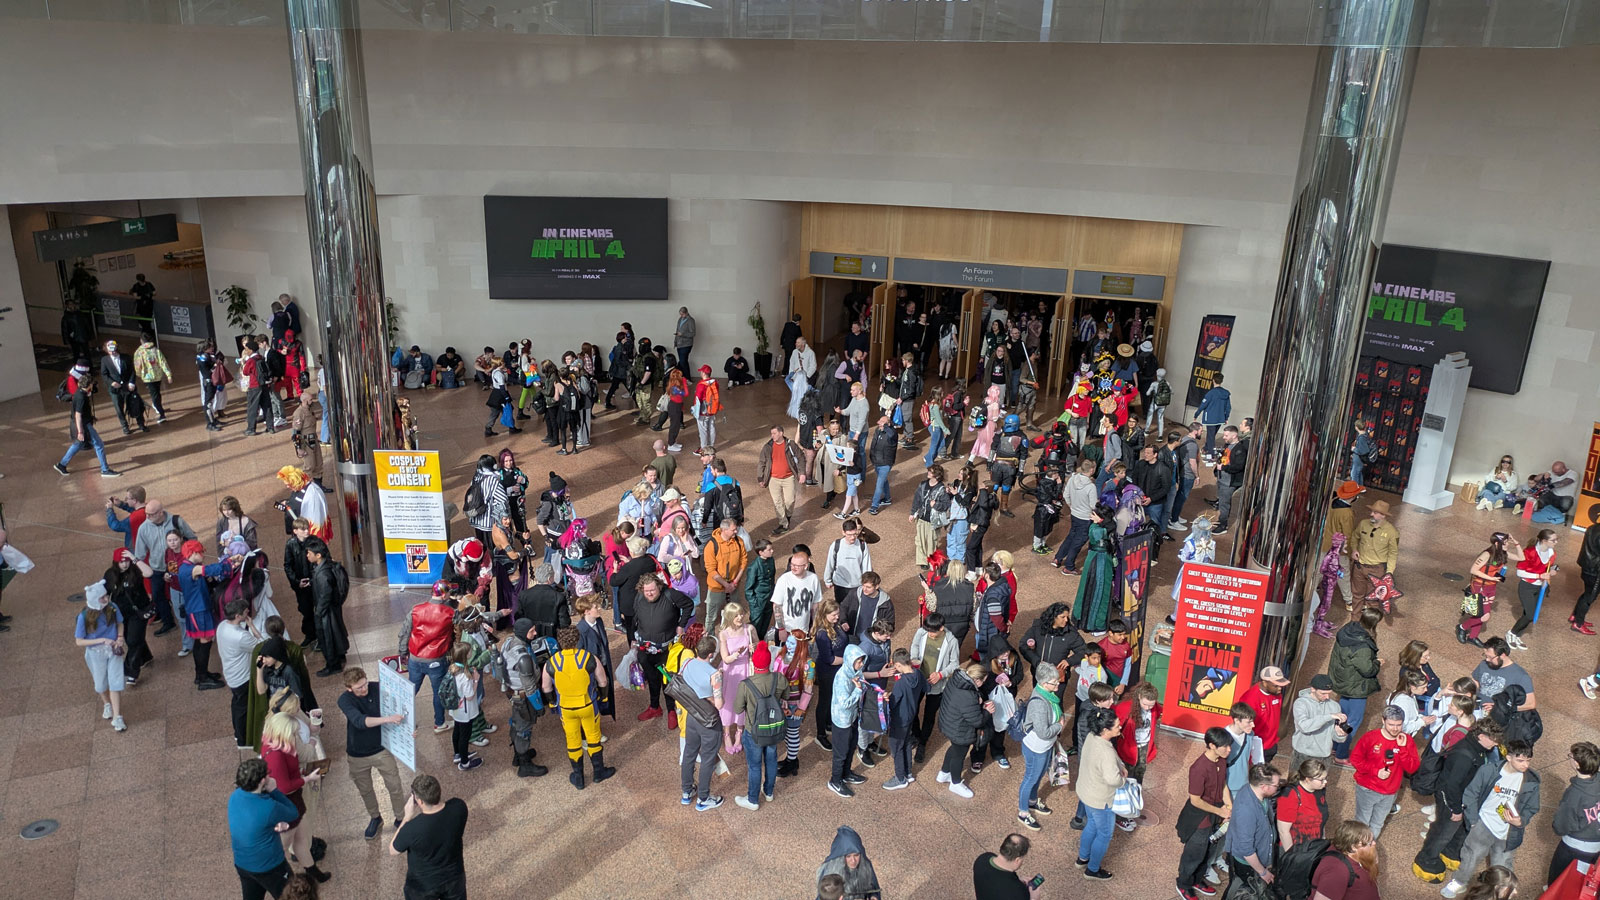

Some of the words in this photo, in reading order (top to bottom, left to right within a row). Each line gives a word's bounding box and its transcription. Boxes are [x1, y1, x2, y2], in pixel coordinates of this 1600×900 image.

[543, 228, 557, 238] IN
[560, 228, 613, 238] CINEMAS
[531, 240, 600, 259] APRIL
[604, 240, 625, 258] 4
[1372, 282, 1382, 294] N
[1384, 284, 1456, 304] CINEMAS
[1368, 296, 1432, 326] PRIL
[1439, 307, 1466, 331] 4
[1205, 323, 1231, 338] COMIC
[1402, 343, 1425, 352] IMAX
[1195, 378, 1212, 390] CON
[389, 456, 426, 467] COSPLAY
[388, 474, 431, 486] CONSENT
[407, 547, 427, 556] COMIC
[1193, 638, 1235, 651] DUBLIN
[1184, 644, 1240, 672] COMIC
[1179, 700, 1231, 716] DUBLINCOMICCON.COM
